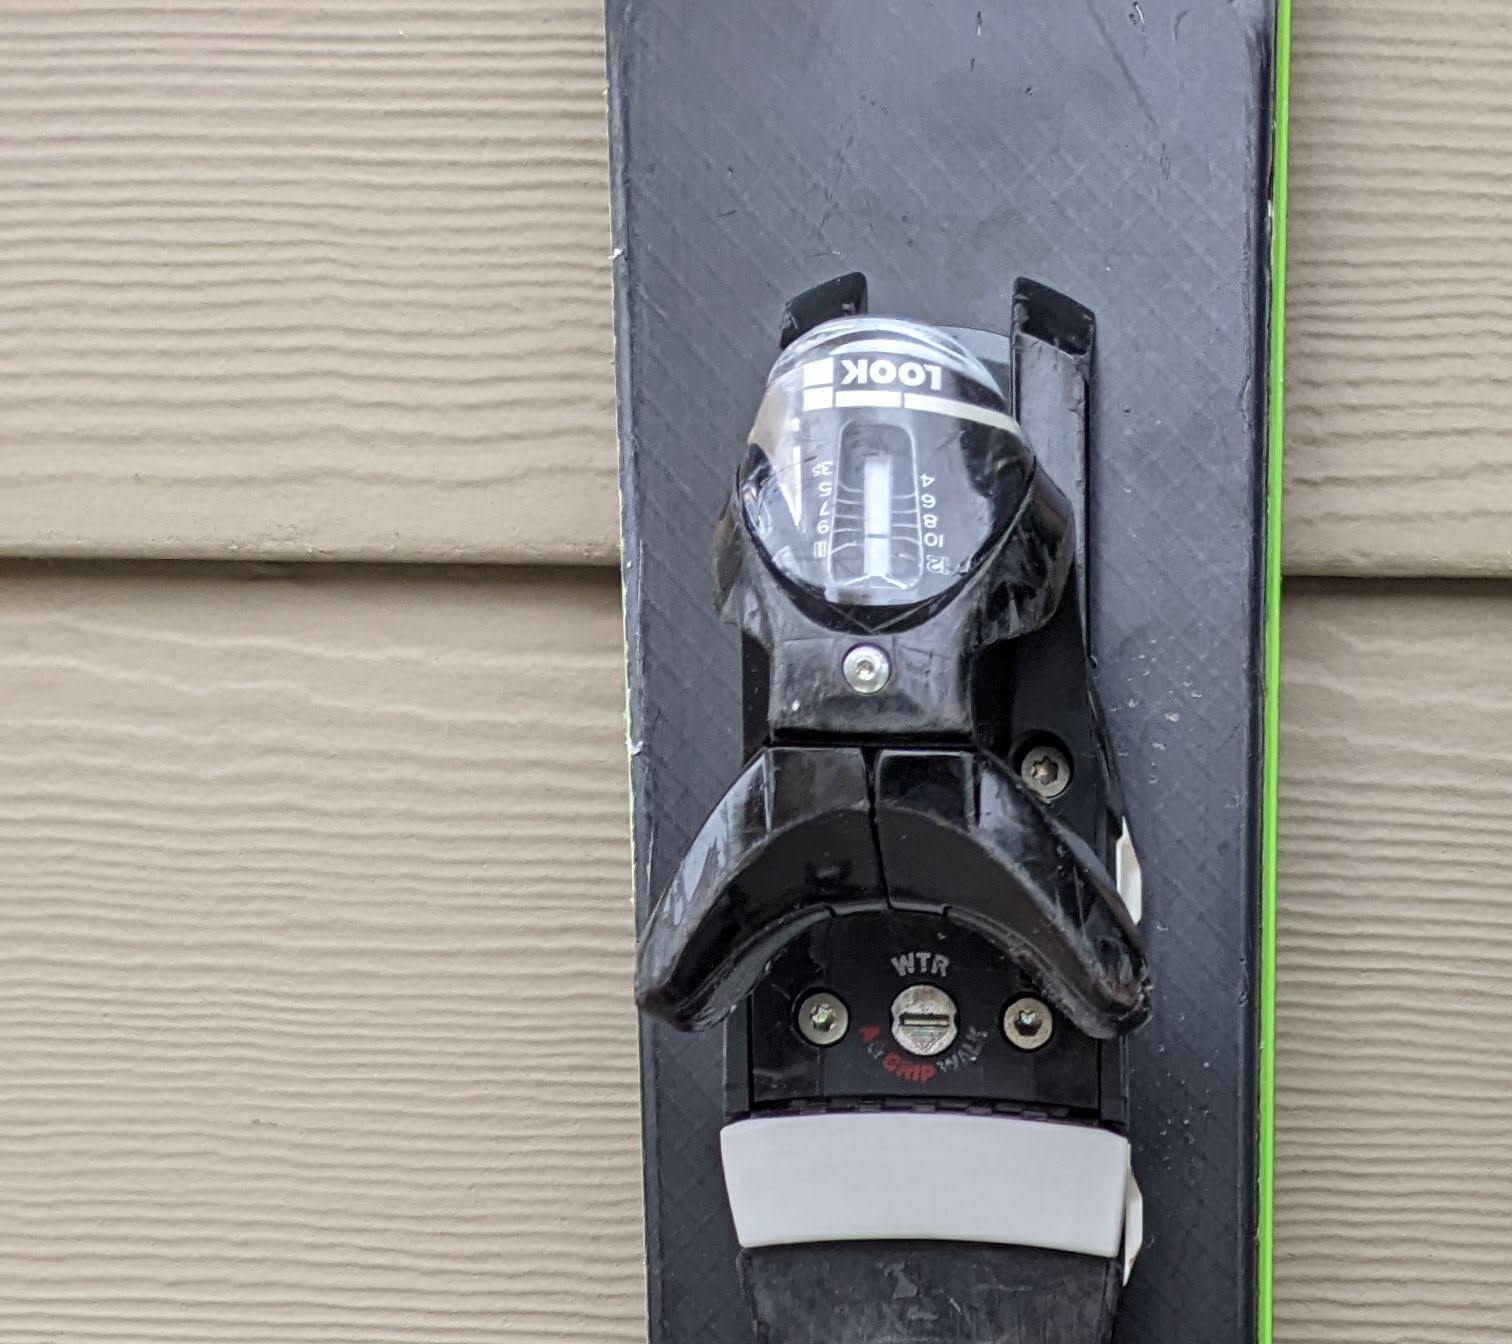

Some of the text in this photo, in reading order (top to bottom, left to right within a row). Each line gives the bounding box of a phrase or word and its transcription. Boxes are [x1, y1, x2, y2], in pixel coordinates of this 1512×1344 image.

[841, 359, 942, 390] LOOK
[923, 514, 938, 528] 8
[924, 534, 944, 548] 10
[891, 952, 950, 977] WTR
